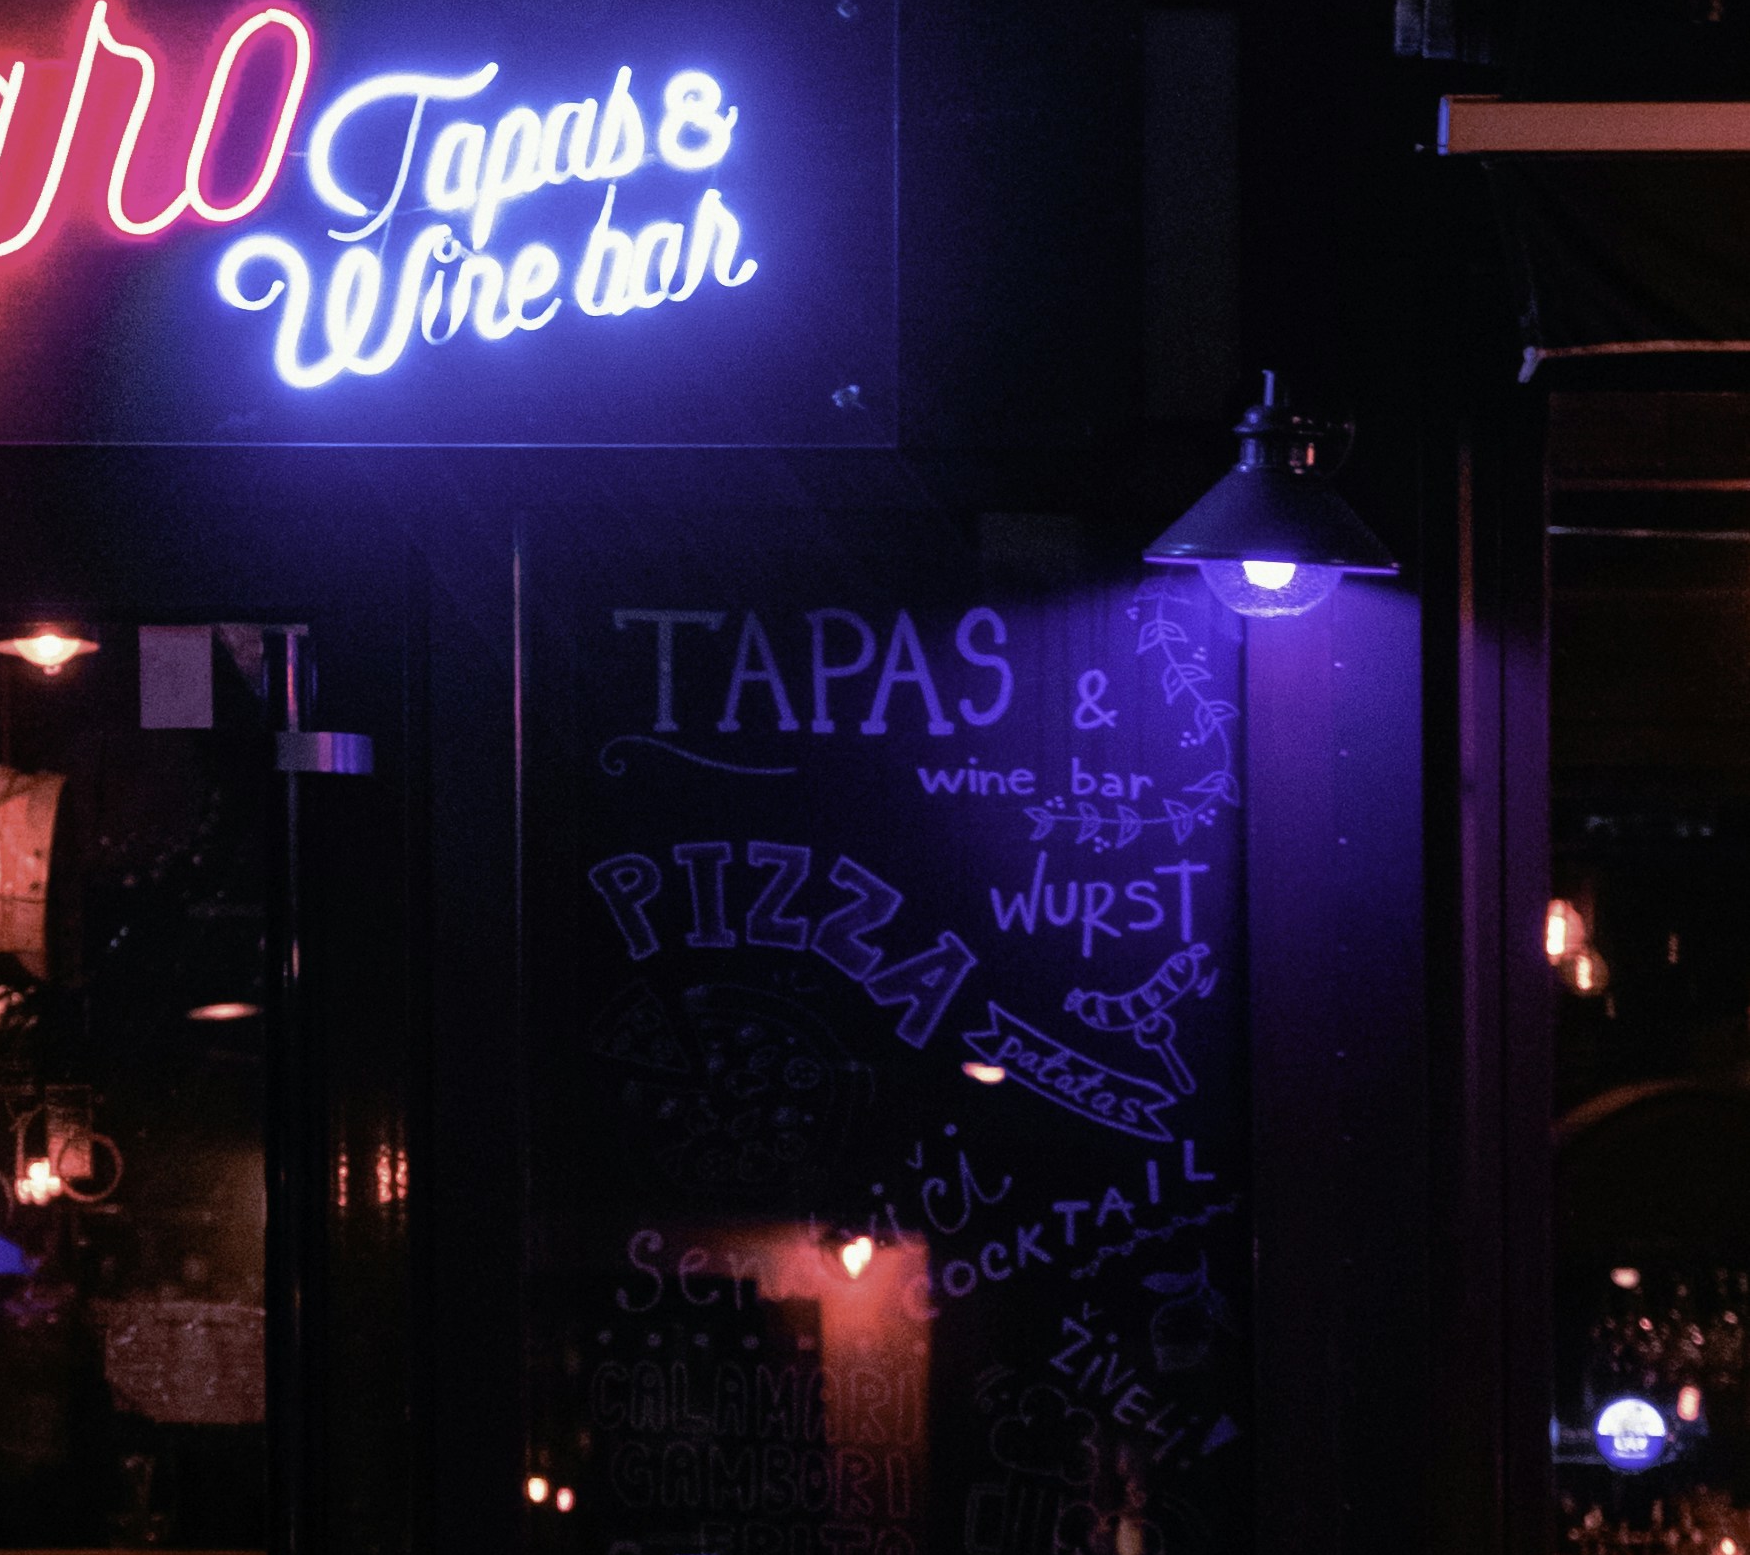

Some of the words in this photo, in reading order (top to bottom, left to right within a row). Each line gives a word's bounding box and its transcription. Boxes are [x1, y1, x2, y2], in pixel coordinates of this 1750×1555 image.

[308, 62, 646, 250] Tapas
[658, 70, 739, 170] &
[216, 224, 563, 390] Wine
[574, 184, 758, 317] bar
[611, 605, 1015, 737] TAPAS
[1072, 666, 1120, 731] &
[915, 754, 1037, 796] wine
[1070, 755, 1155, 801] bar
[587, 839, 979, 1050] PIZZA
[988, 849, 1211, 960] WURST
[992, 1033, 1145, 1126] patatas
[900, 1138, 1217, 1323] COCKTAIL
[588, 1357, 923, 1447] CALAMARI
[611, 1439, 913, 1522] GAMBORI
